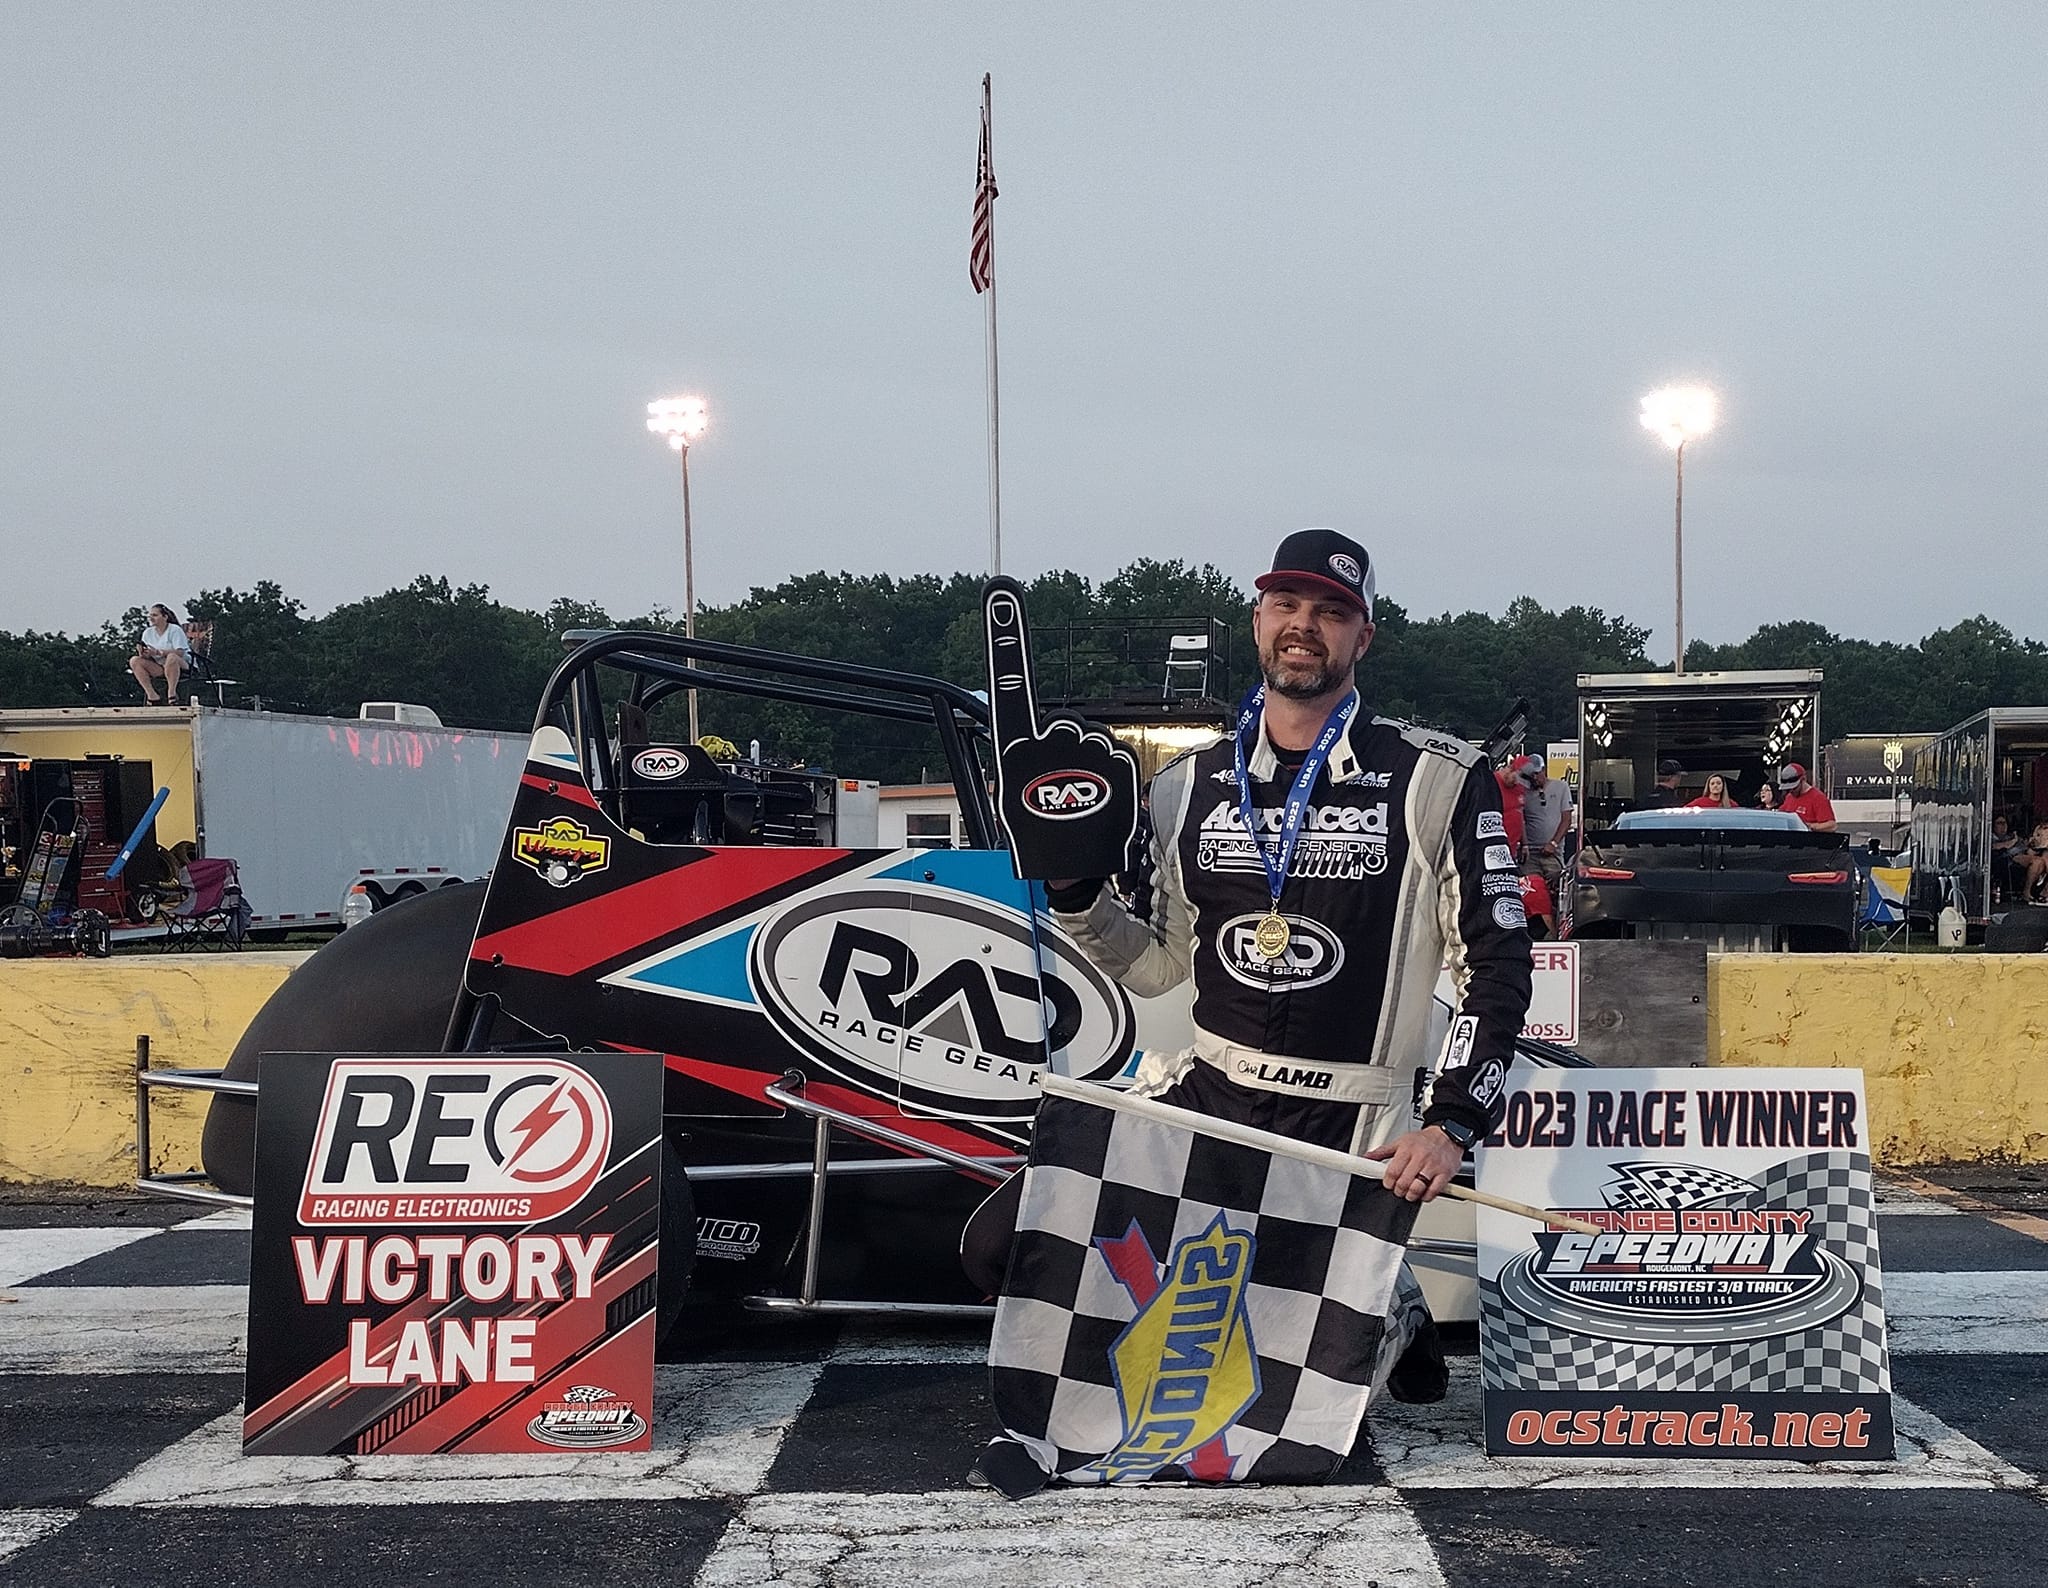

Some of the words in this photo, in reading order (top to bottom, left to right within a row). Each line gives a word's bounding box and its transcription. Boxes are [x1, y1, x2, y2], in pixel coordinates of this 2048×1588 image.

[1337, 559, 1358, 578] RAD
[1252, 682, 1265, 706] SAC
[1317, 727, 1337, 752] 2023
[1424, 738, 1460, 755] RAD
[643, 757, 680, 769] RAD
[1298, 758, 1318, 788] USAC
[1038, 782, 1098, 805] RAD
[1286, 801, 1300, 830] 2023
[545, 828, 581, 842] RAD
[1200, 840, 1256, 853] RACING
[1235, 960, 1270, 974] RACE
[1273, 967, 1313, 977] GEAR
[818, 920, 1082, 1065] RAD
[818, 1010, 924, 1053] RACE
[1258, 1063, 1333, 1090] LAMB
[1586, 1090, 1687, 1148] RACE
[1696, 1090, 1858, 1148] WINNER
[312, 1199, 389, 1218] RACING
[394, 1199, 532, 1217] ELECTRONICS
[696, 1217, 760, 1246] ICO
[1680, 1210, 1811, 1233] COUNTY
[1546, 1233, 1808, 1274] SPEEDWAY
[291, 1233, 614, 1304] VICTORY
[1695, 1265, 1706, 1273] NC
[1569, 1280, 1648, 1292] AMERICA'S
[1648, 1281, 1715, 1293] FASTEST
[1717, 1281, 1743, 1295] 3/8
[1745, 1281, 1794, 1293] TRACK
[1628, 1295, 1701, 1305] ESTABLISHED
[348, 1317, 538, 1385] LANE
[543, 1409, 631, 1425] SPEEDWAY
[1506, 1403, 1871, 1449] ocstrack.net
